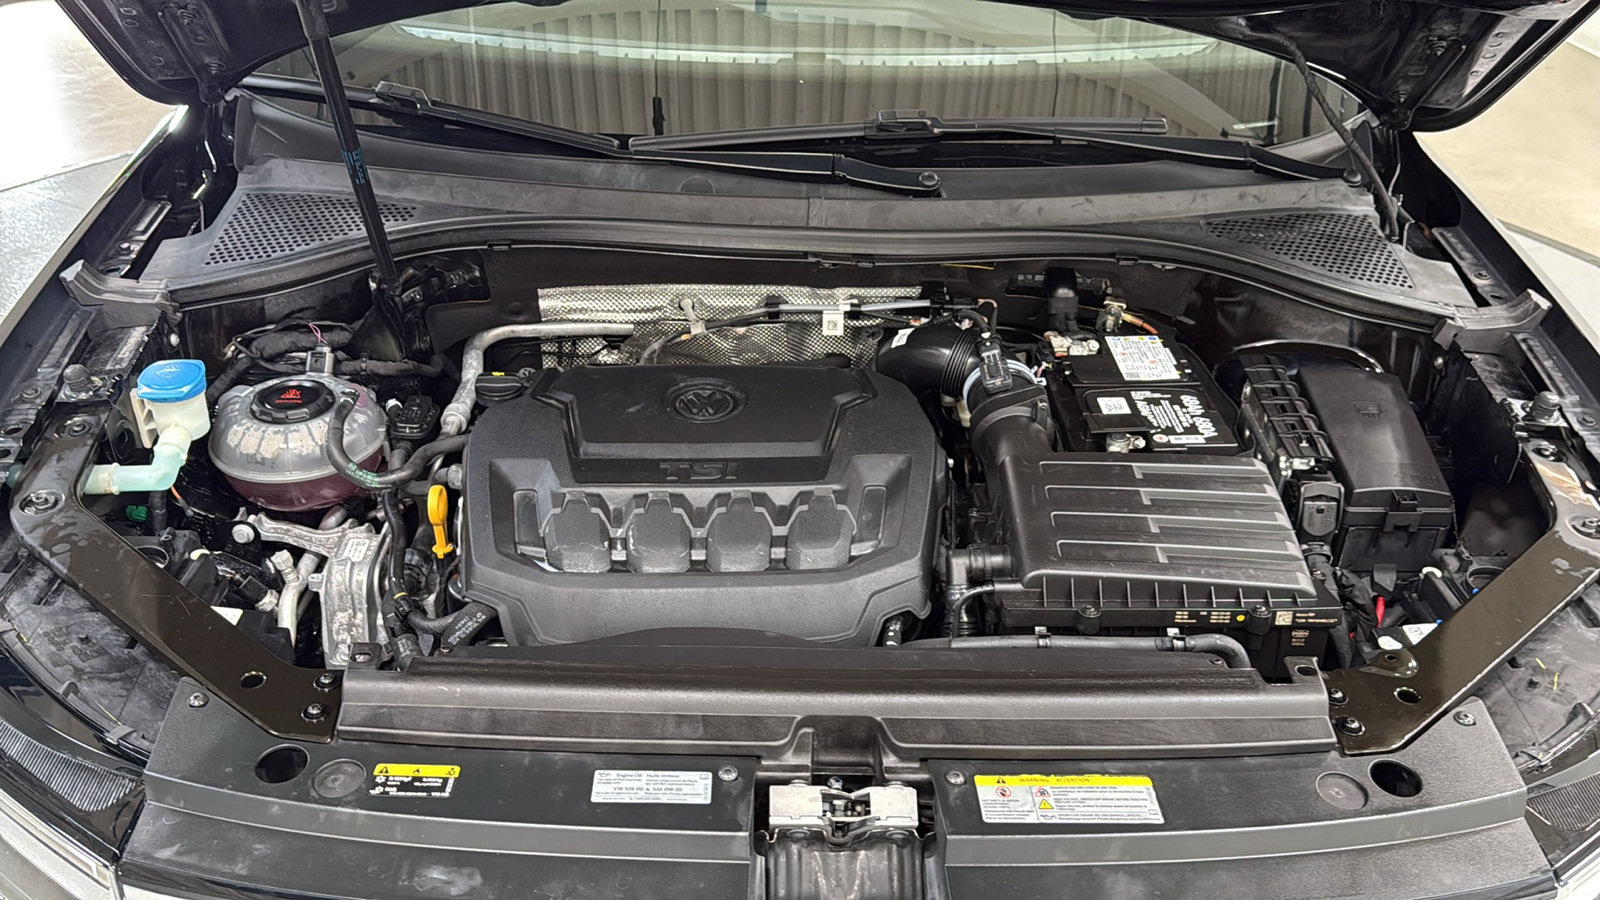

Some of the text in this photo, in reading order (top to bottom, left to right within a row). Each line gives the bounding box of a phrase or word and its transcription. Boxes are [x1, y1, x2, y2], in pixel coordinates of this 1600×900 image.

[670, 383, 739, 421] VW
[1180, 395, 1205, 415] 68Ah
[659, 462, 740, 480] TSI
